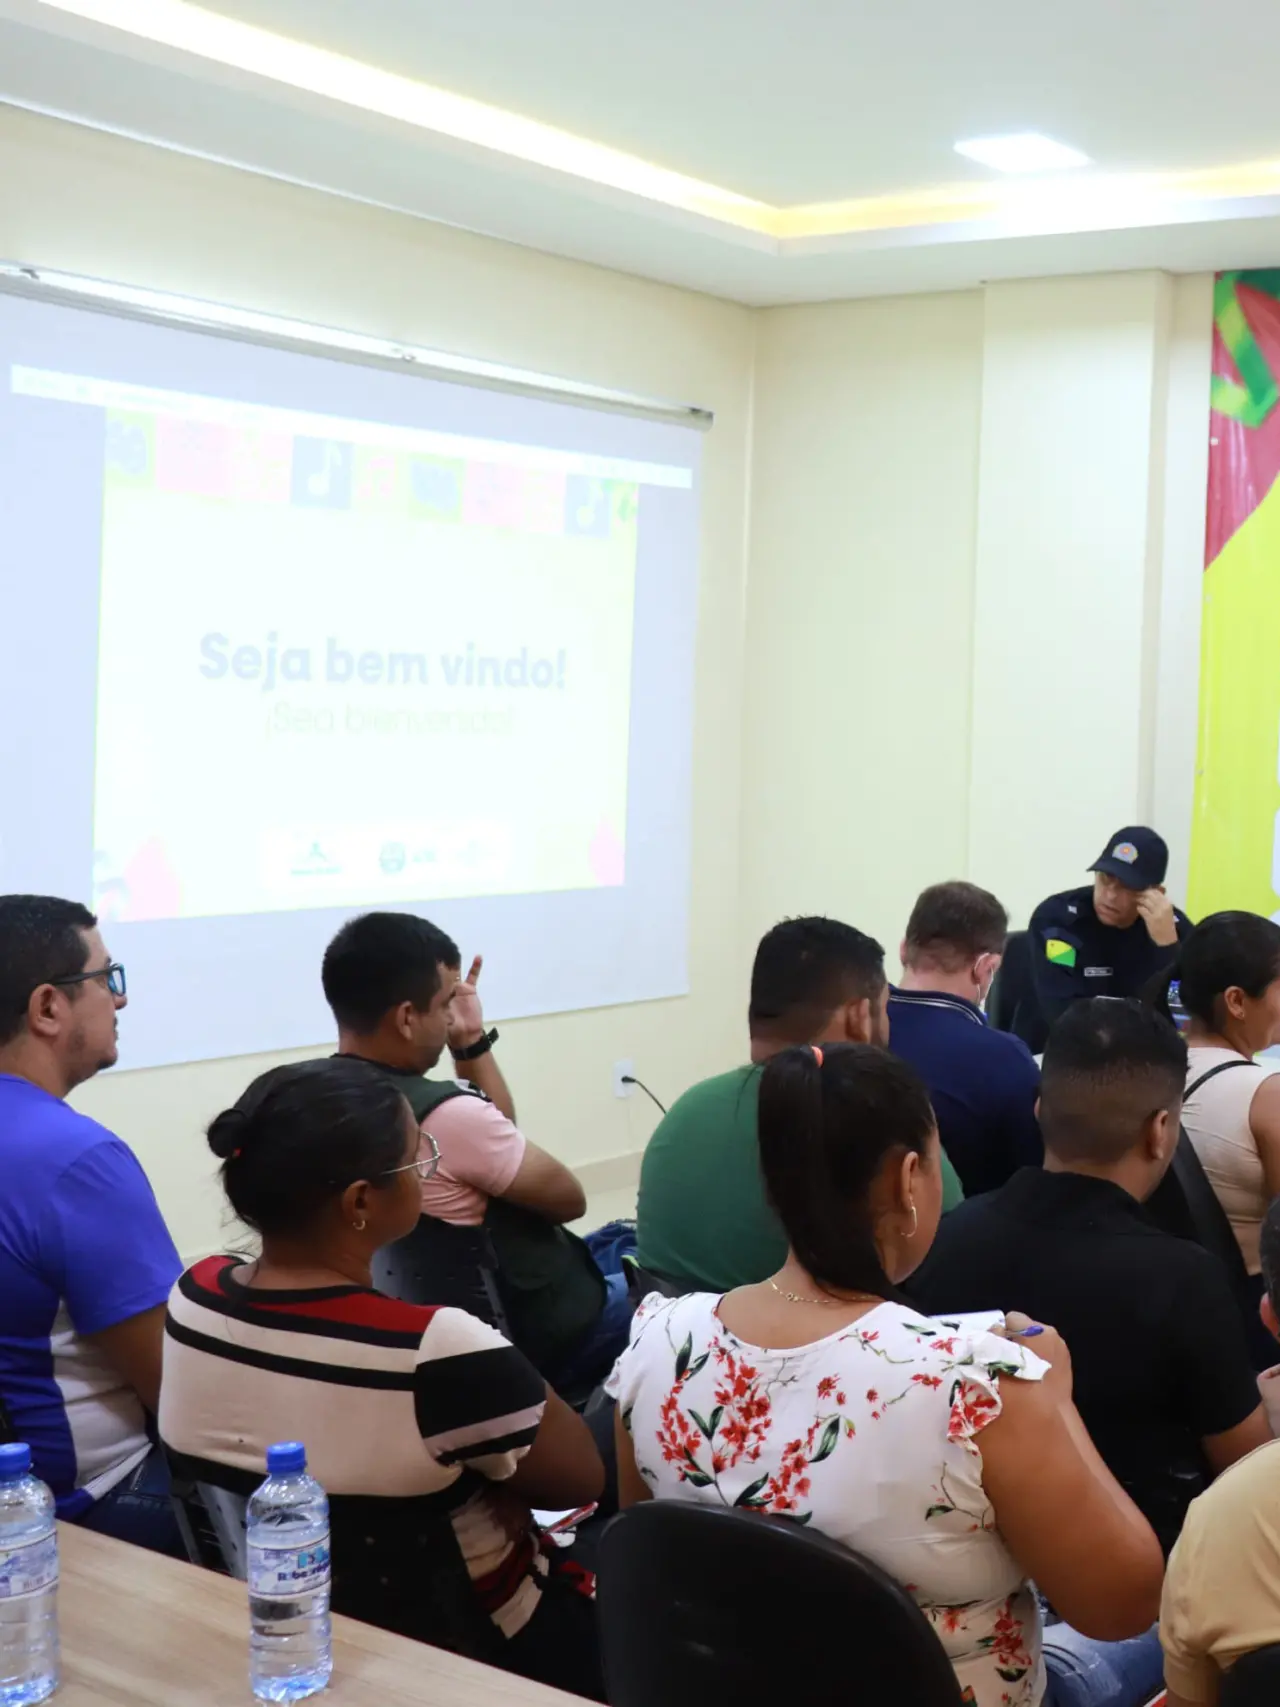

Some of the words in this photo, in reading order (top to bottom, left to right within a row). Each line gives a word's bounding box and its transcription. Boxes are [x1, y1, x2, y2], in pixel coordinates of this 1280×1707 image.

[199, 631, 312, 693] Seja
[326, 636, 428, 686] bem
[440, 641, 567, 690] vindo!
